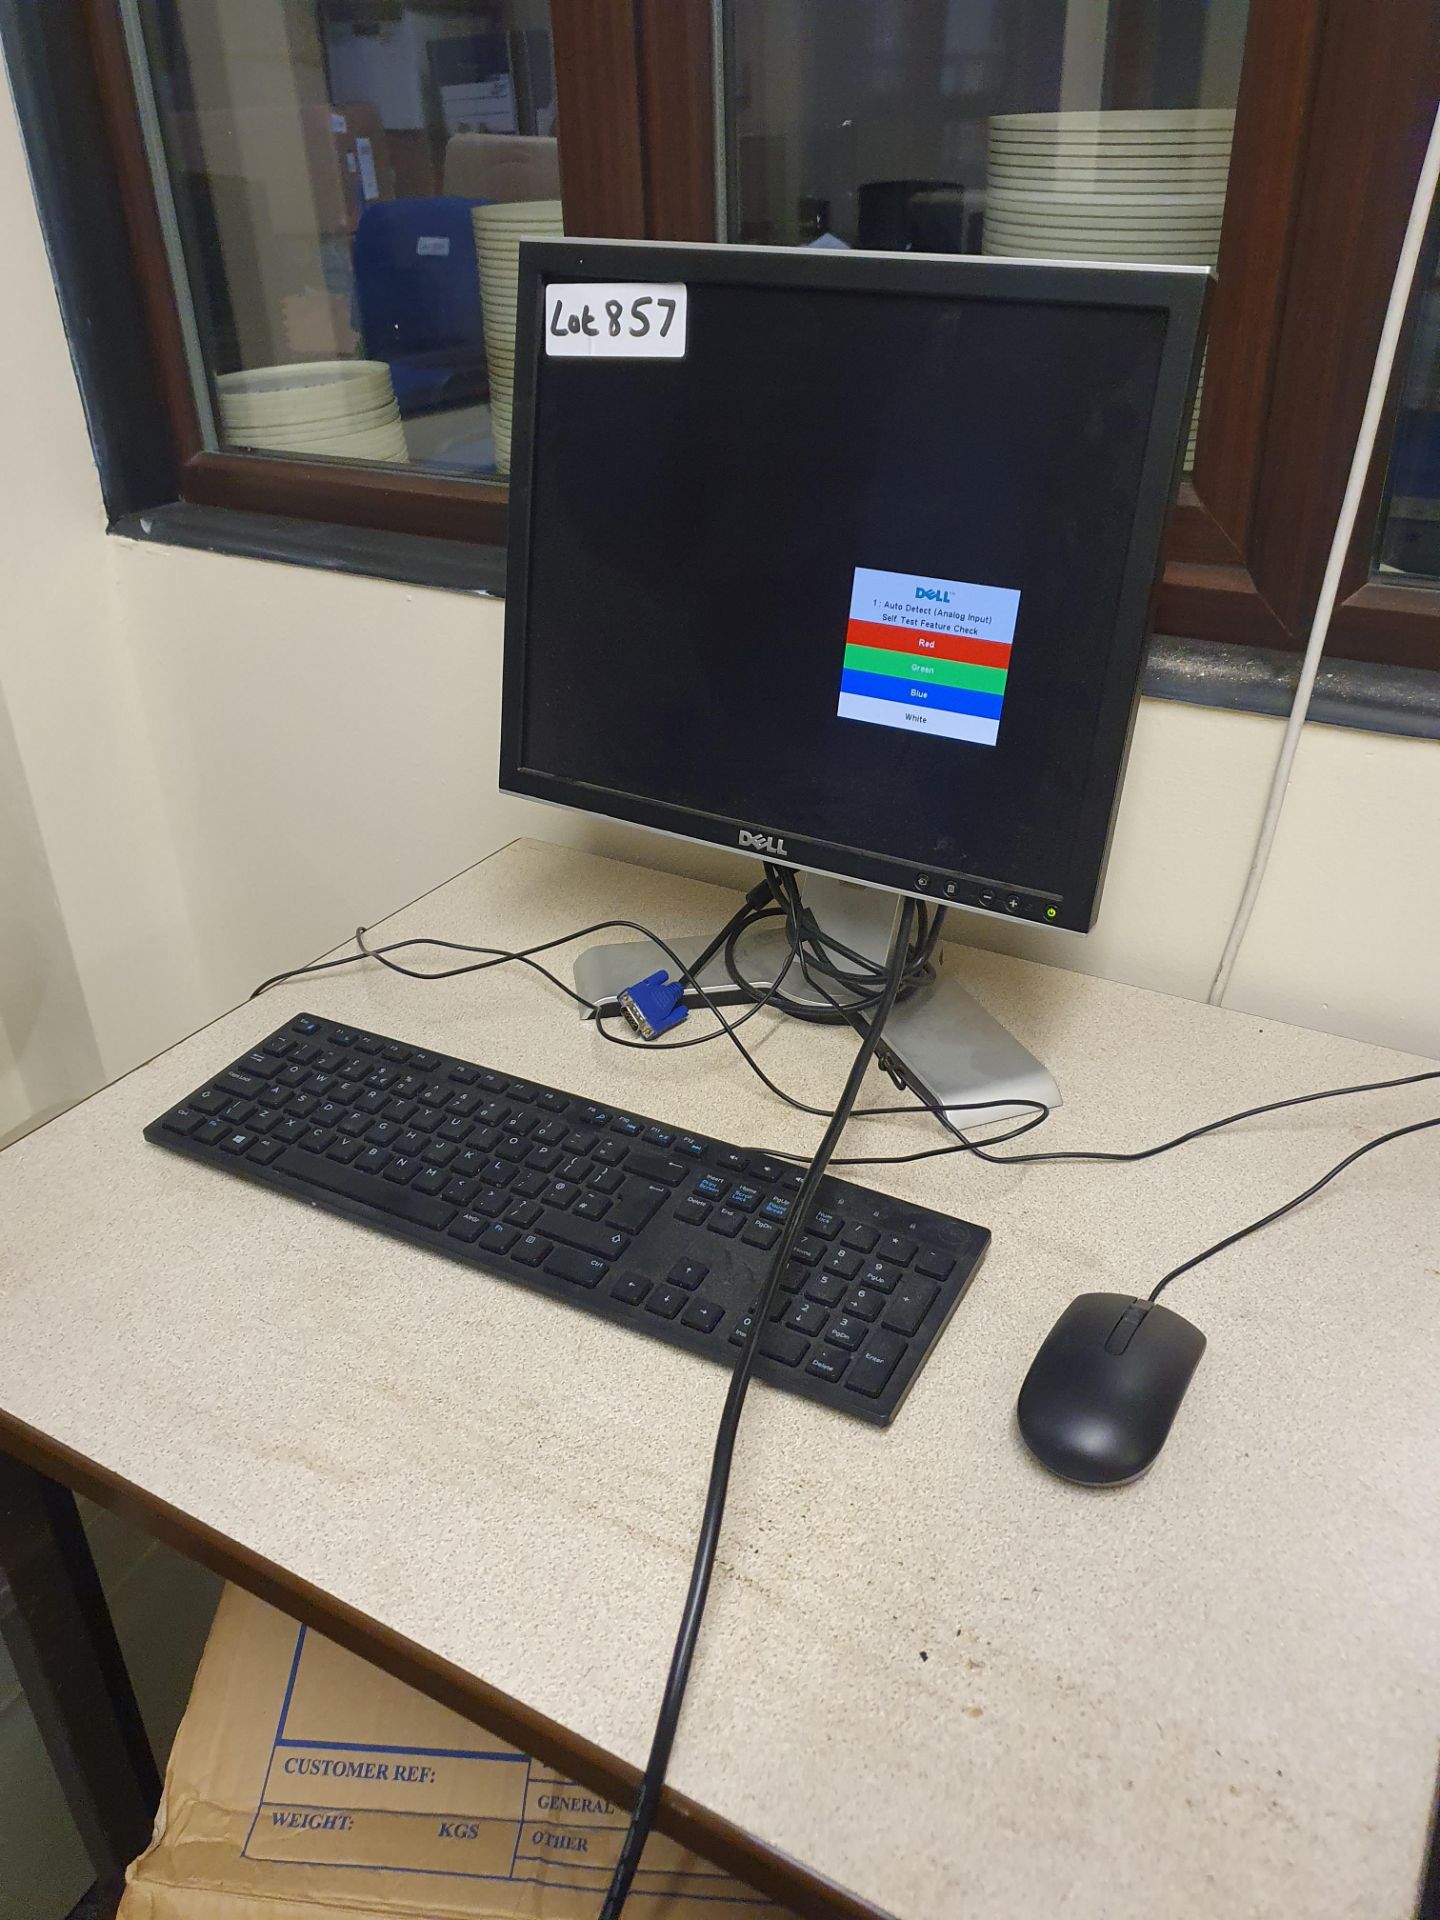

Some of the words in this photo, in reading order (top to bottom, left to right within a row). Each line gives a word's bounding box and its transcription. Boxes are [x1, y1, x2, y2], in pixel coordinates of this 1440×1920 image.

[551, 300, 600, 336] Lot
[605, 296, 676, 337] 857
[915, 587, 950, 603] DELL
[884, 601, 903, 611] Auto
[906, 604, 931, 615] Detect
[934, 607, 965, 621] (Analog
[968, 613, 992, 625] Input)
[882, 613, 897, 622] Self
[901, 617, 918, 626] Test
[920, 620, 951, 632] Feature
[953, 624, 978, 635] Check
[918, 639, 935, 649] Red
[911, 664, 934, 674] Green
[910, 688, 928, 699] Blue
[905, 713, 928, 724] White
[738, 830, 787, 856] DELL
[755, 1220, 772, 1230] PgDn
[820, 1276, 829, 1284] 5
[858, 1290, 866, 1298] 6
[801, 1304, 810, 1312] 2
[840, 1318, 849, 1326] 3
[865, 1352, 885, 1364] Enter
[812, 1359, 834, 1372] Delete
[284, 1757, 390, 1781] CUSTOMER
[393, 1765, 436, 1784] REF:
[537, 1794, 615, 1815] GENERAL
[271, 1811, 354, 1832] WEIGHT:
[438, 1823, 479, 1840] KGS
[531, 1830, 589, 1853] OTHER
